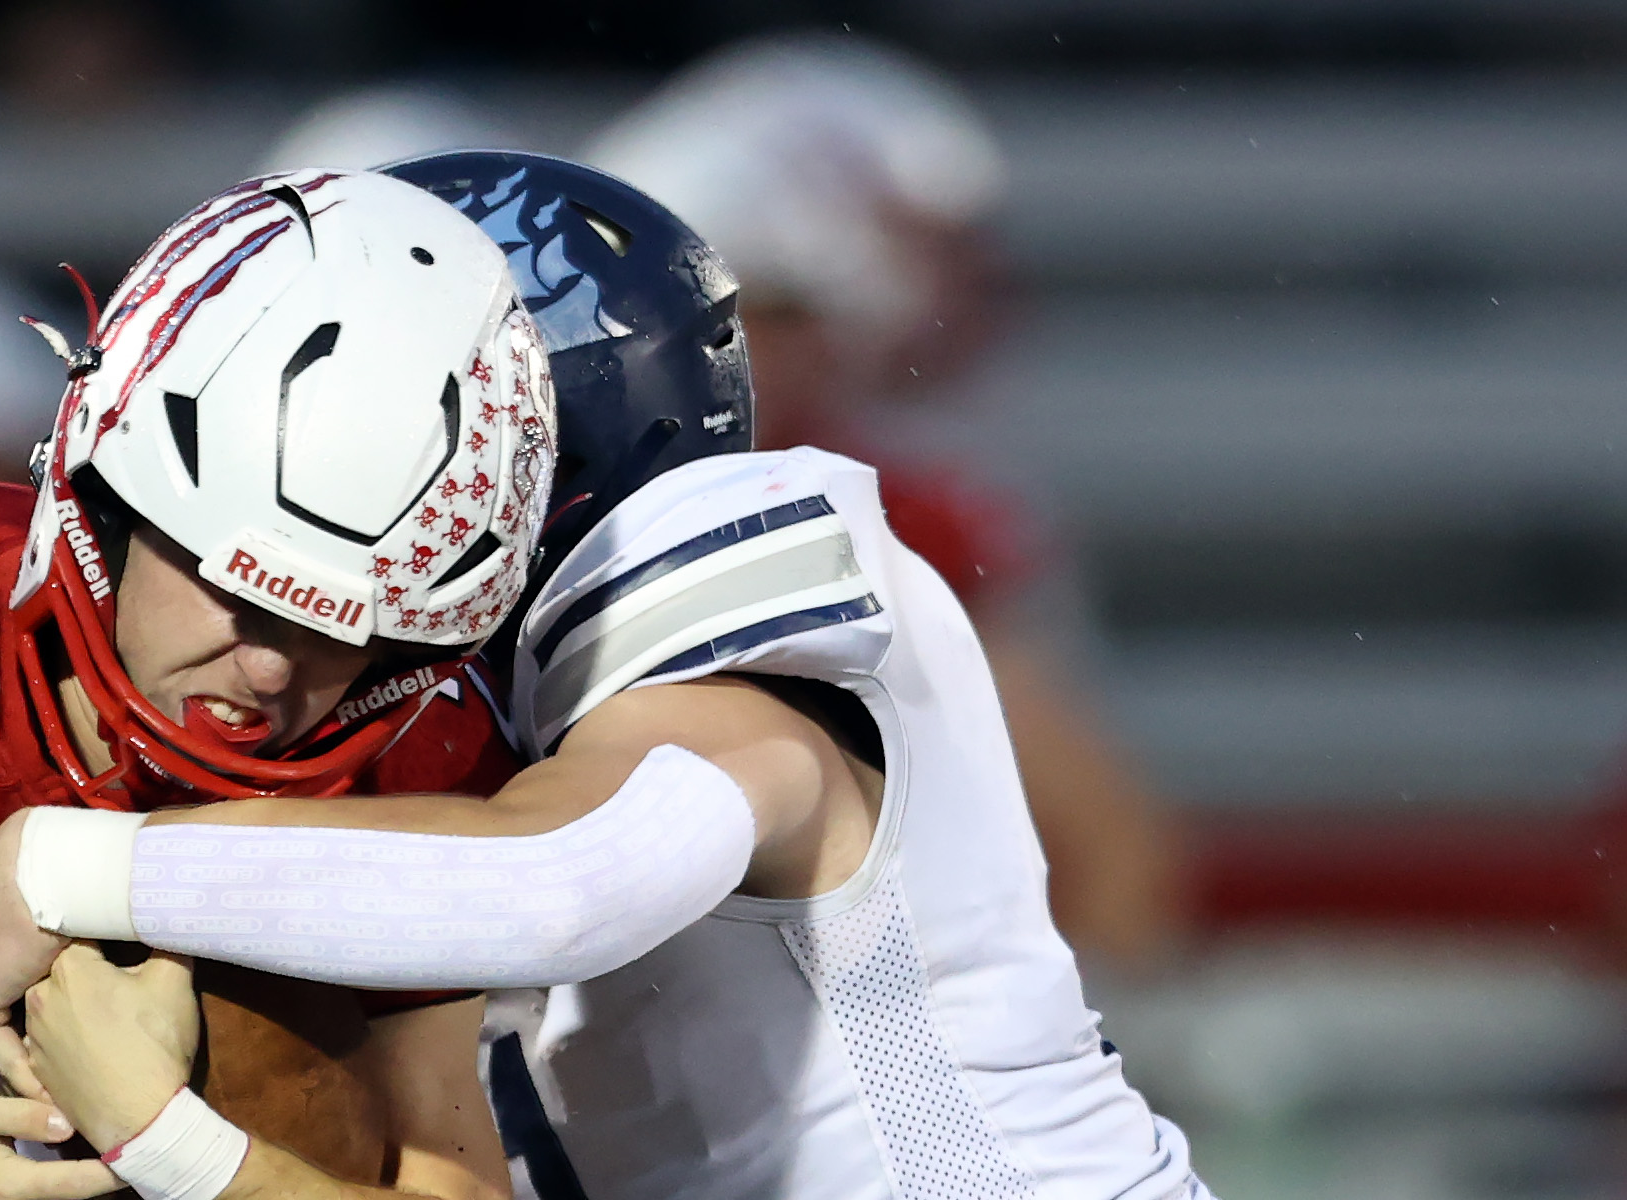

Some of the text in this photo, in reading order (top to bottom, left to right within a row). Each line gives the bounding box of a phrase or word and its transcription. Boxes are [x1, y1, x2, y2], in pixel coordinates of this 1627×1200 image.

[54, 498, 111, 601] Riddell
[226, 548, 366, 628] Riddell
[335, 666, 436, 725] Riddell
